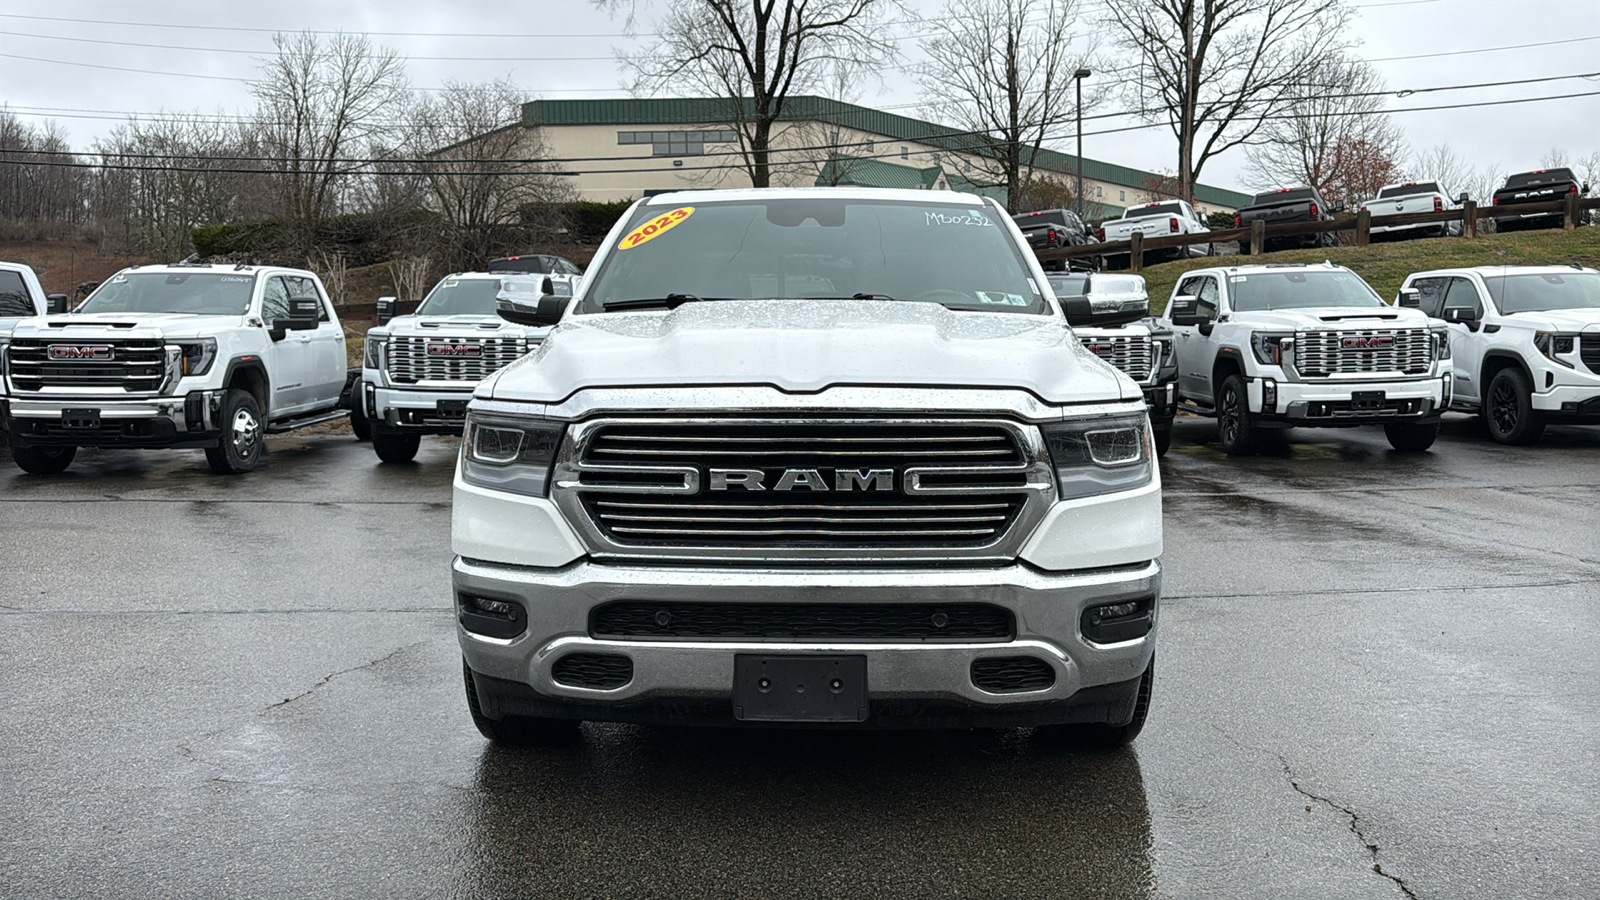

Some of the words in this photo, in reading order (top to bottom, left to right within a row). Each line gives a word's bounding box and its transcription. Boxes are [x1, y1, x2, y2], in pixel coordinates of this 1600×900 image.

[1514, 189, 1554, 200] RAM
[1256, 208, 1294, 219] RAM
[627, 209, 688, 246] 2023
[1343, 337, 1393, 348] GMC
[52, 347, 109, 358] GMC
[429, 345, 480, 355] GMC
[709, 468, 894, 491] RAM
